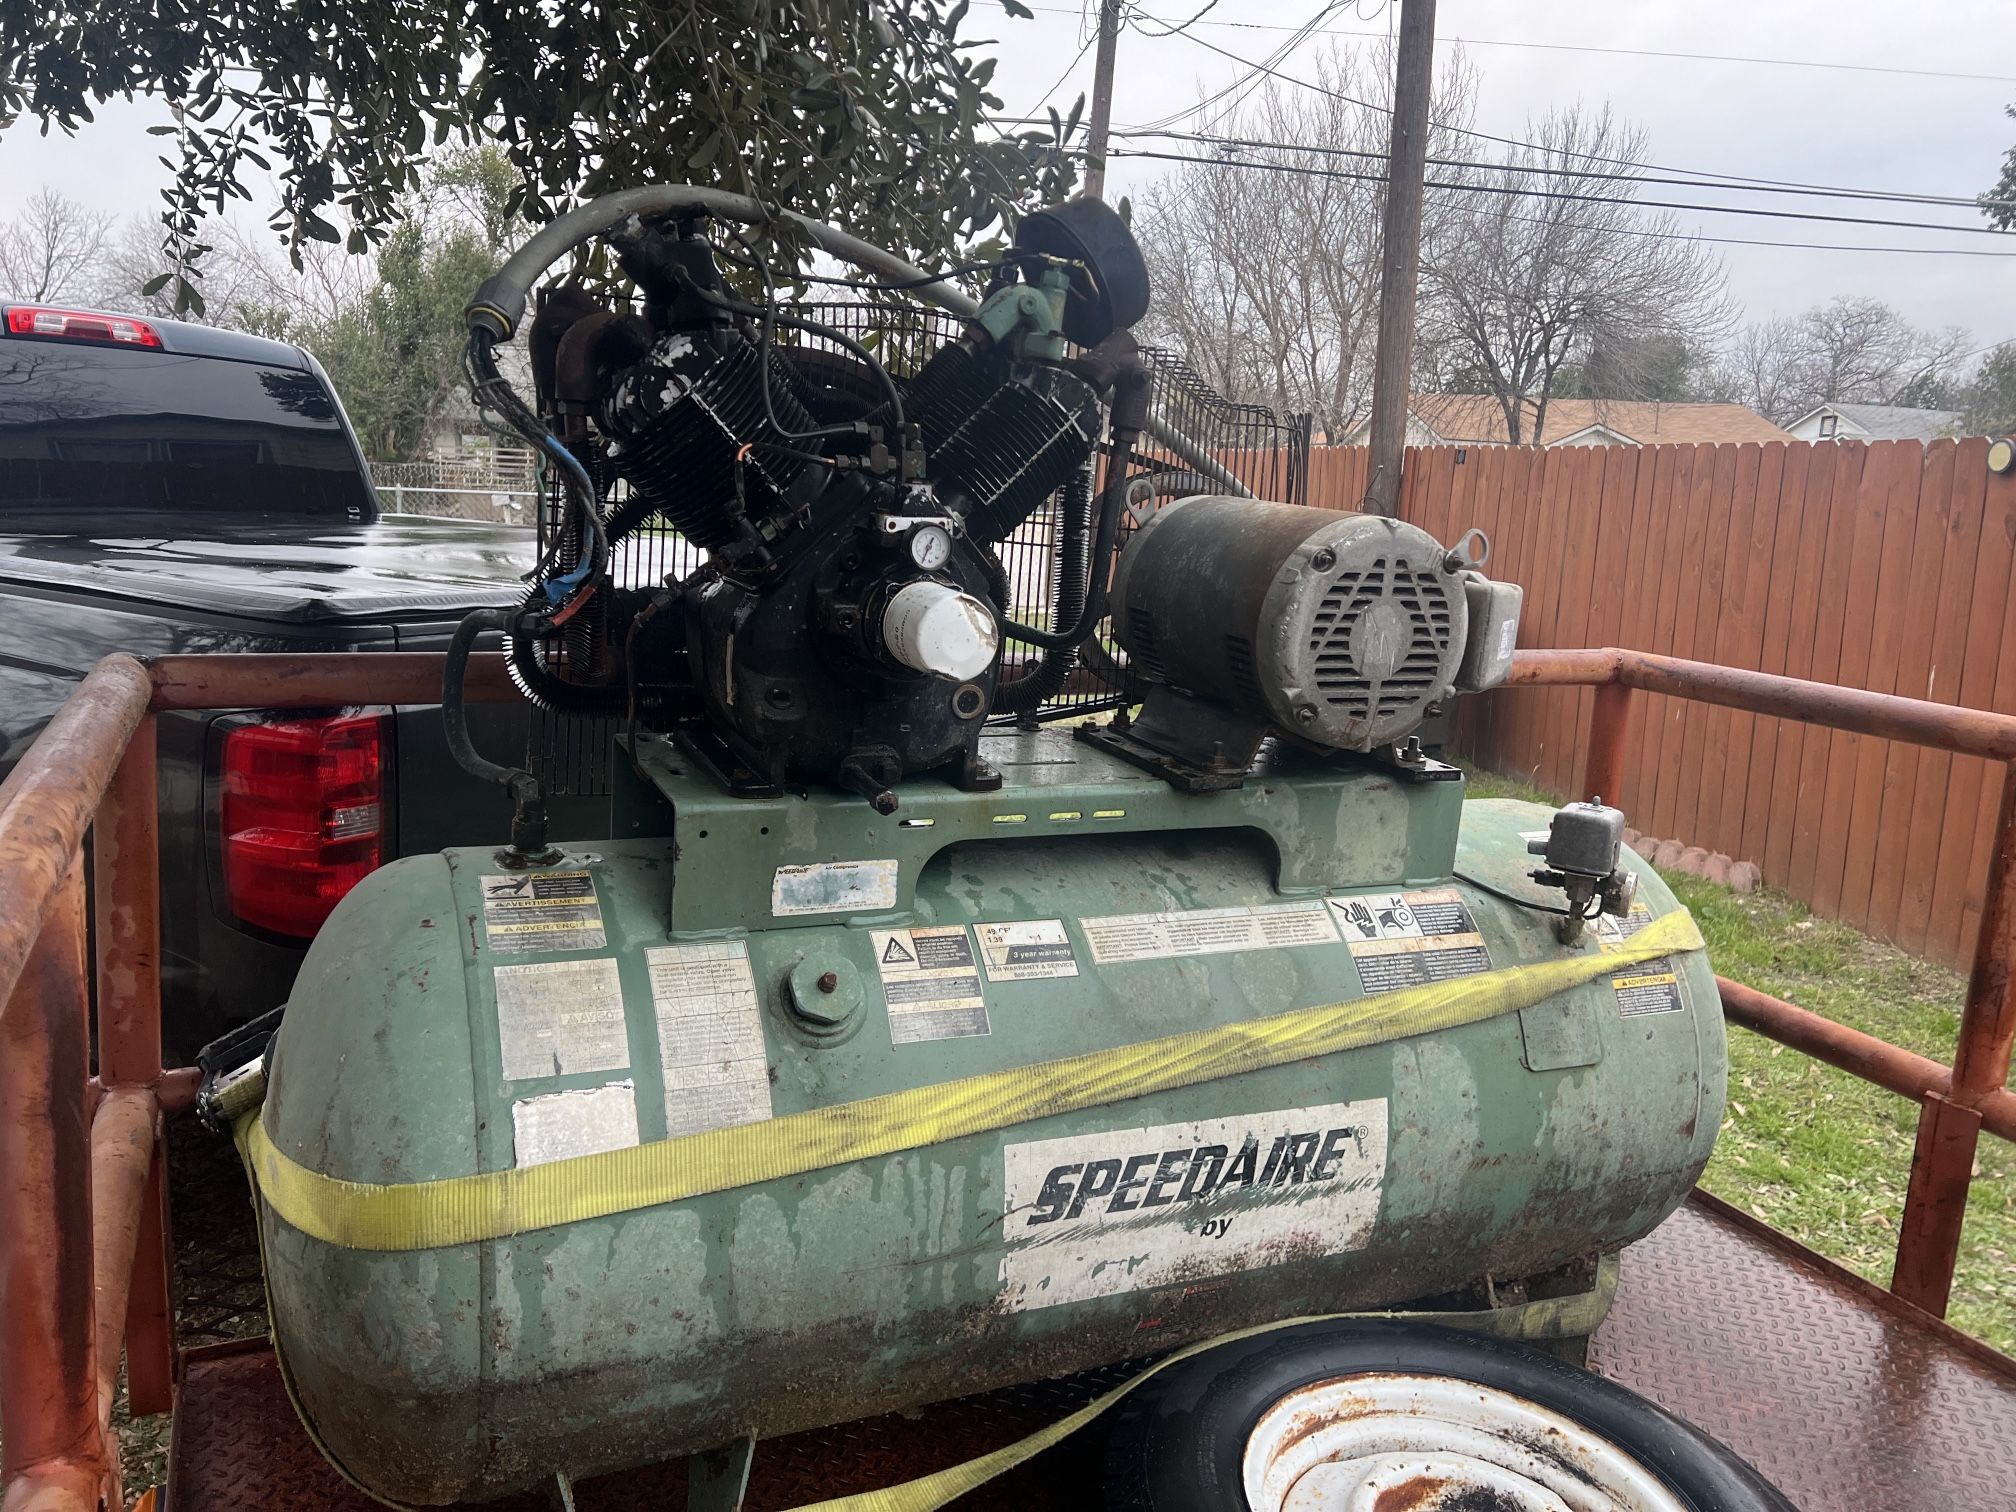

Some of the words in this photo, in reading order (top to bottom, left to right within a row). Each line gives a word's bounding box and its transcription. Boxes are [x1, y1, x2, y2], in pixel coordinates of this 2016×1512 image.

[1020, 951, 1036, 960] year
[1038, 948, 1072, 957] warranty
[1003, 964, 1040, 972] WARRANTY
[1027, 1126, 1355, 1226] SPEEDAIRE
[1200, 1215, 1233, 1239] by
